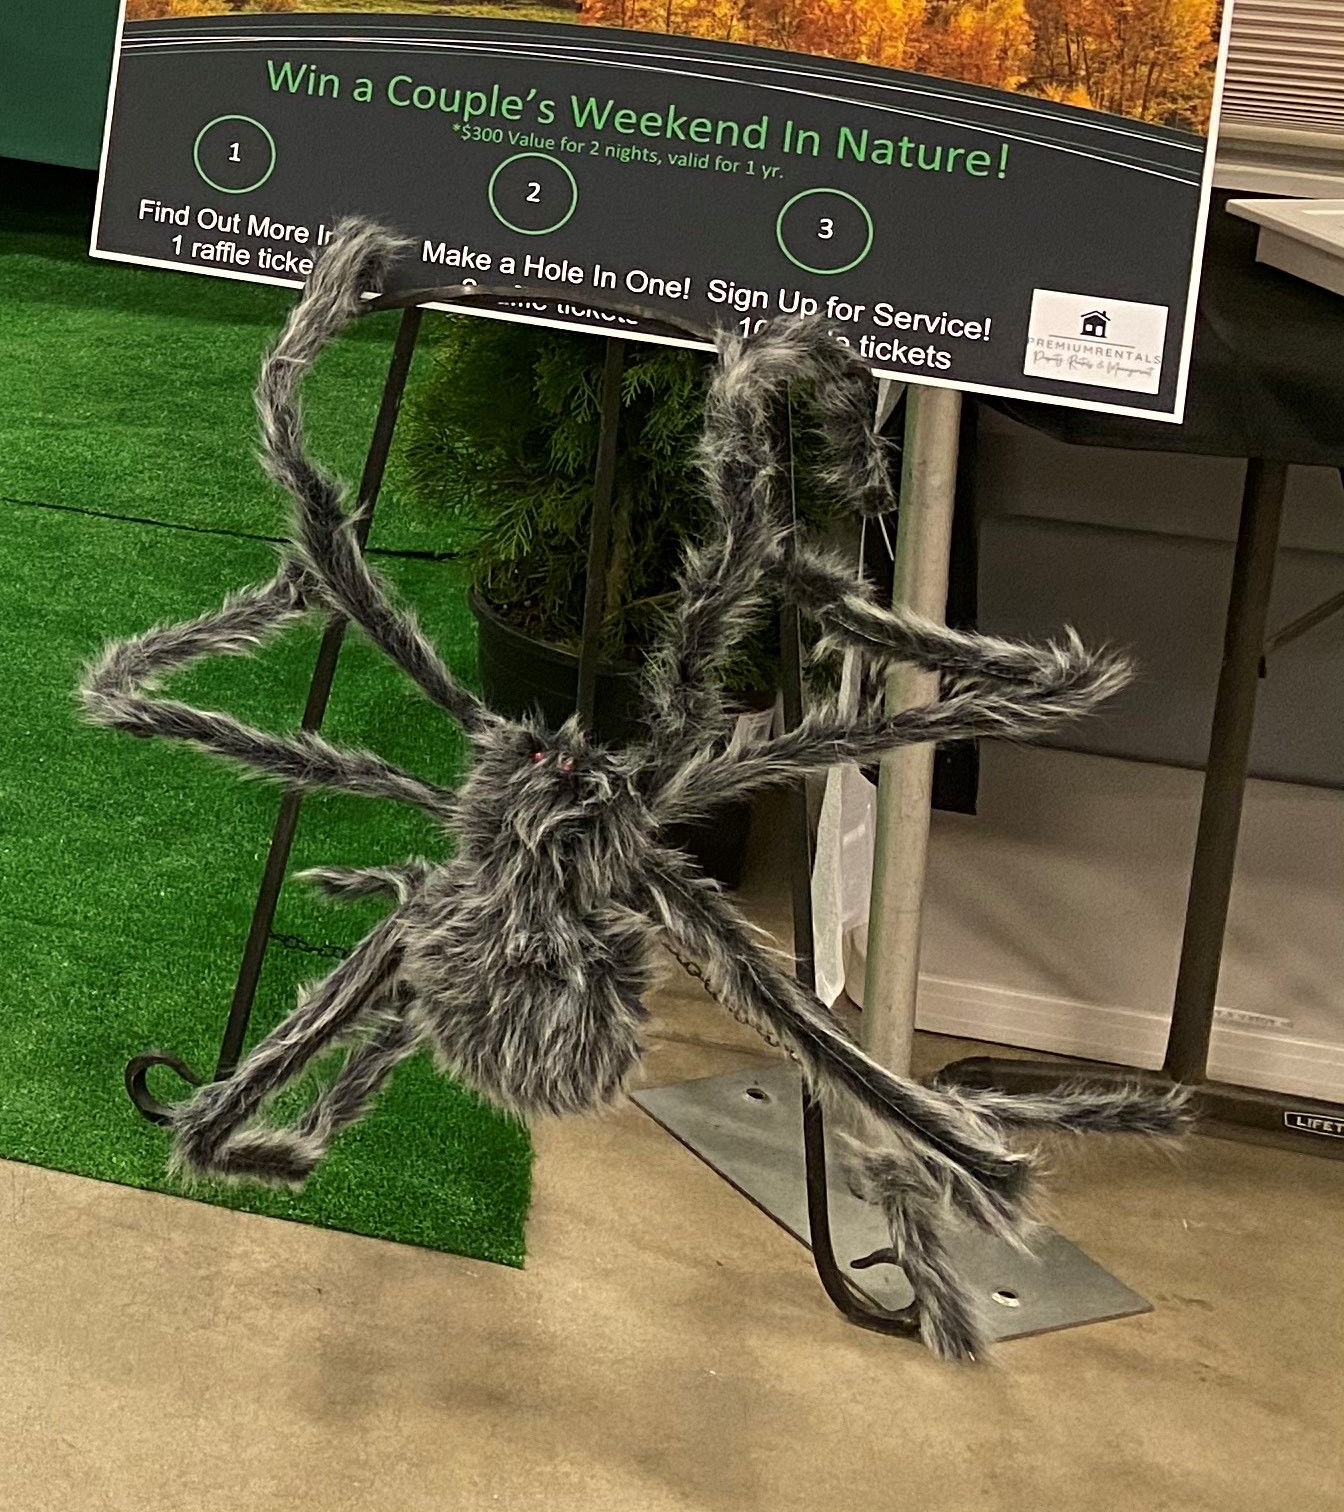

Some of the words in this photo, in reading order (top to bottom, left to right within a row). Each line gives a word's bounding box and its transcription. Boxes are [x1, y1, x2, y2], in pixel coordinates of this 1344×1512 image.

[266, 59, 340, 99] Win
[352, 77, 373, 102] a
[387, 74, 555, 124] Couple's
[571, 95, 768, 150] Weekend
[782, 120, 821, 157] In
[836, 126, 1010, 180] Nature!
[229, 143, 242, 162] 1
[508, 131, 554, 149] Value
[561, 137, 585, 153] for
[590, 143, 599, 156] 2
[605, 144, 662, 166] nights,
[668, 151, 709, 169] valid
[715, 156, 739, 172] for
[745, 161, 755, 175] 1
[762, 164, 784, 179] yr.
[526, 183, 541, 203] 2
[138, 199, 190, 226] Find
[197, 208, 241, 234] Out
[247, 215, 309, 244] More
[817, 219, 834, 239] 3
[172, 234, 182, 255] 1
[191, 240, 251, 266] raffle
[422, 240, 492, 271] Make
[499, 257, 515, 275] a
[523, 254, 584, 284] Hole
[593, 264, 616, 289] In
[626, 269, 691, 300] One!
[707, 278, 768, 312] Sign
[778, 288, 817, 319] Up
[826, 296, 865, 322] for
[872, 302, 992, 341] Service!
[860, 335, 952, 370] tickets
